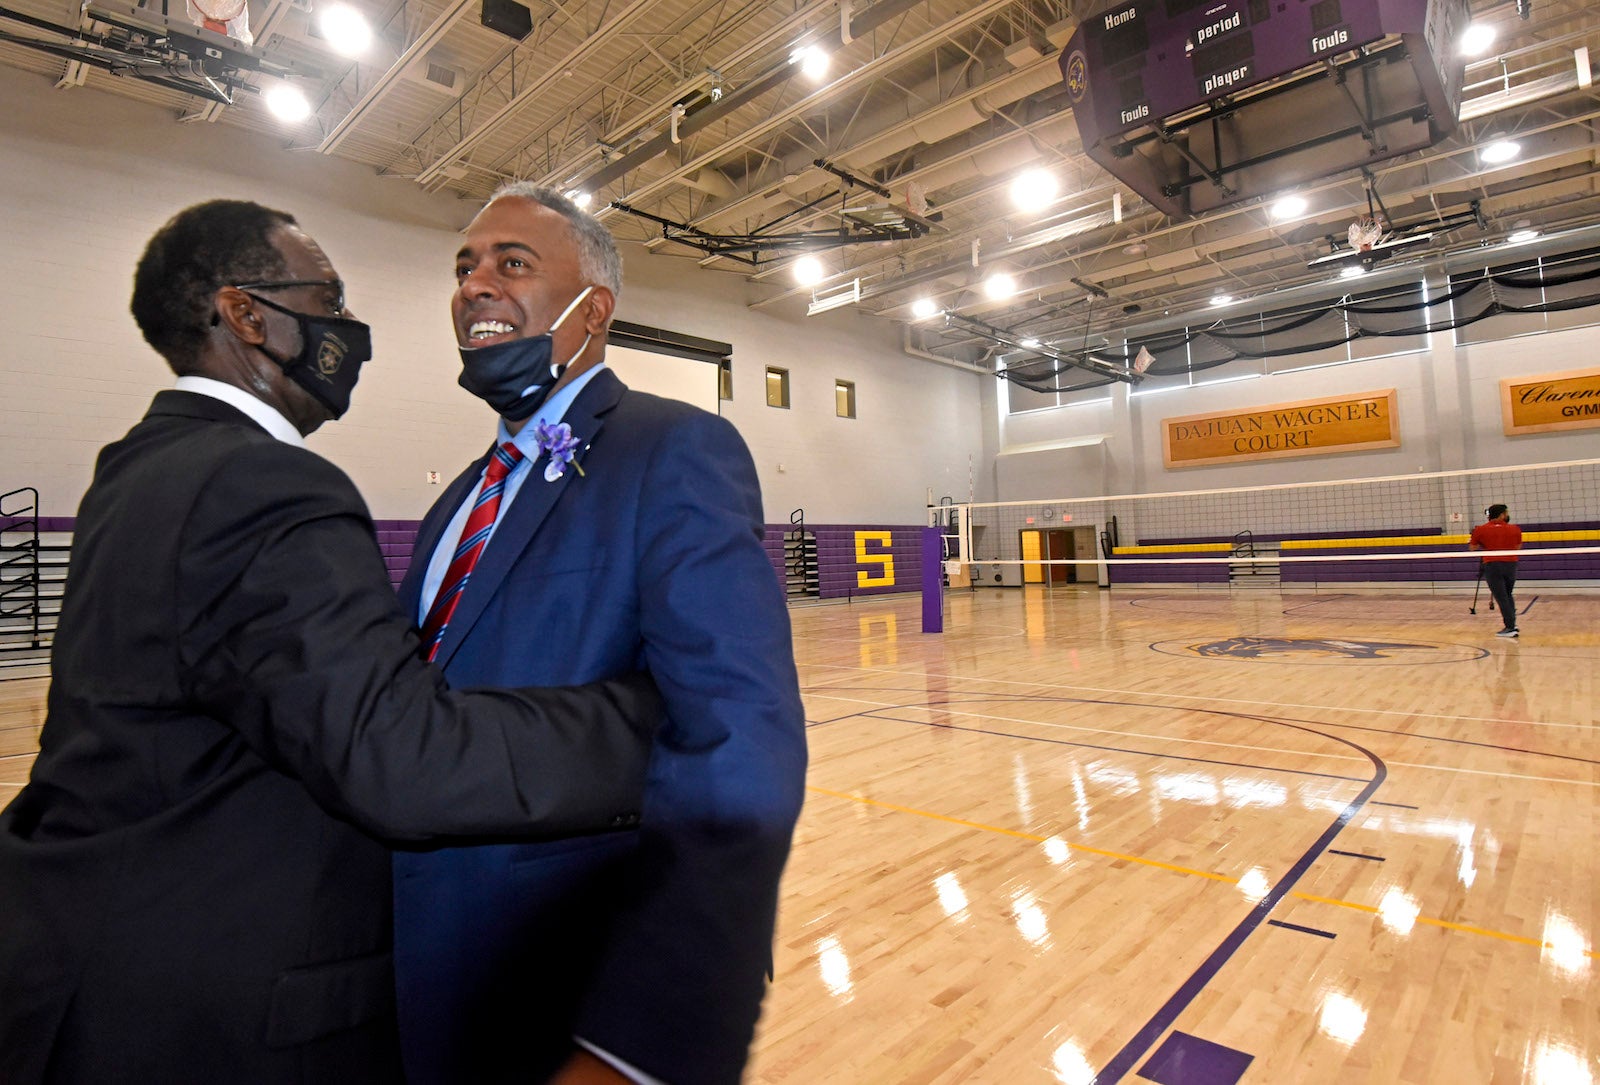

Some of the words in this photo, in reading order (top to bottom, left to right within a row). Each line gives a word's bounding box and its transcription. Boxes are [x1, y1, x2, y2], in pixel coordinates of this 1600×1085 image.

[1104, 7, 1136, 30] Home
[1197, 11, 1241, 44] period
[1312, 30, 1348, 54] fouls
[1205, 66, 1248, 94] player
[1121, 104, 1149, 125] fouls
[1175, 416, 1263, 441] DAJUAN
[1273, 402, 1381, 428] WAGNER
[1561, 403, 1600, 417] GYM
[1234, 429, 1314, 453] COURT
[854, 530, 895, 588] S
